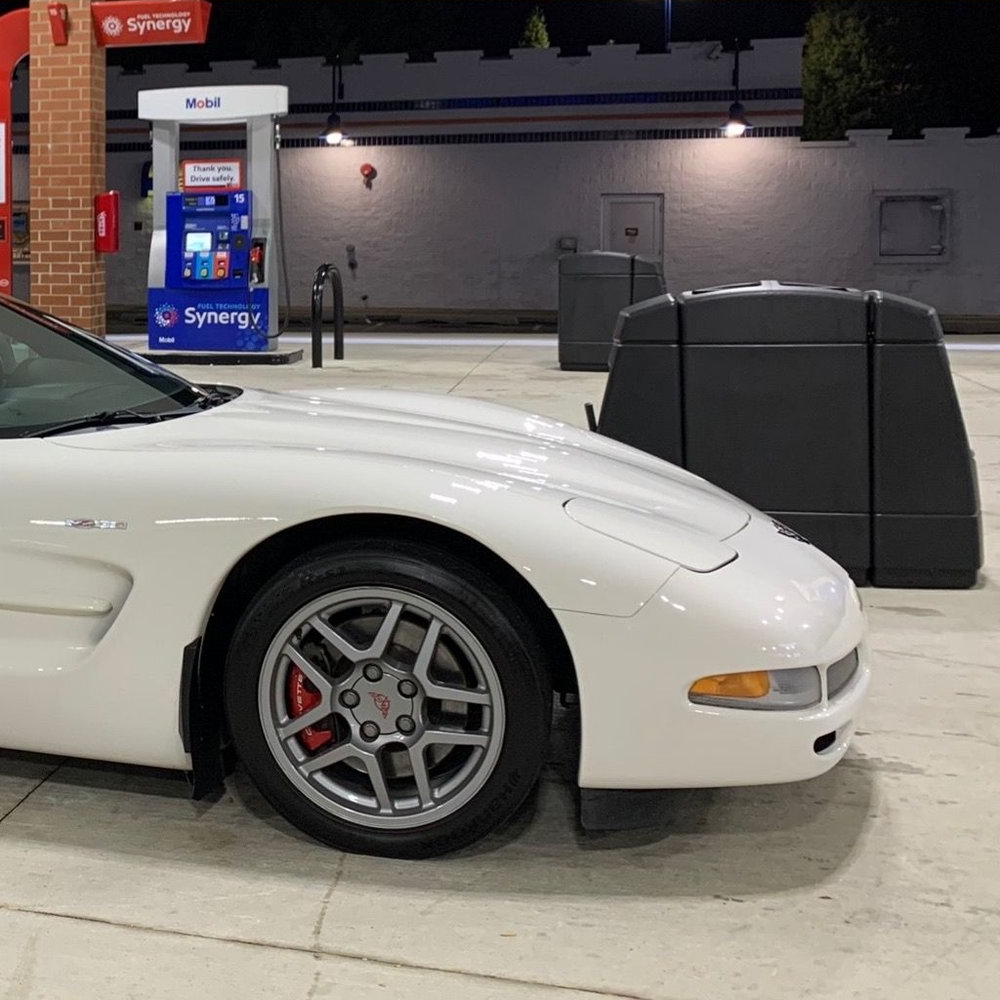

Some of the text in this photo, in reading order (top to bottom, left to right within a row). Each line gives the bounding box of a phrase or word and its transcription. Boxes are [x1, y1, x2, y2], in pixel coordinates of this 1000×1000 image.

[126, 17, 192, 35] Synergy
[185, 97, 221, 109] Mobil
[233, 193, 245, 203] 15
[184, 307, 261, 329] Synergy
[158, 336, 175, 344] Mobil
